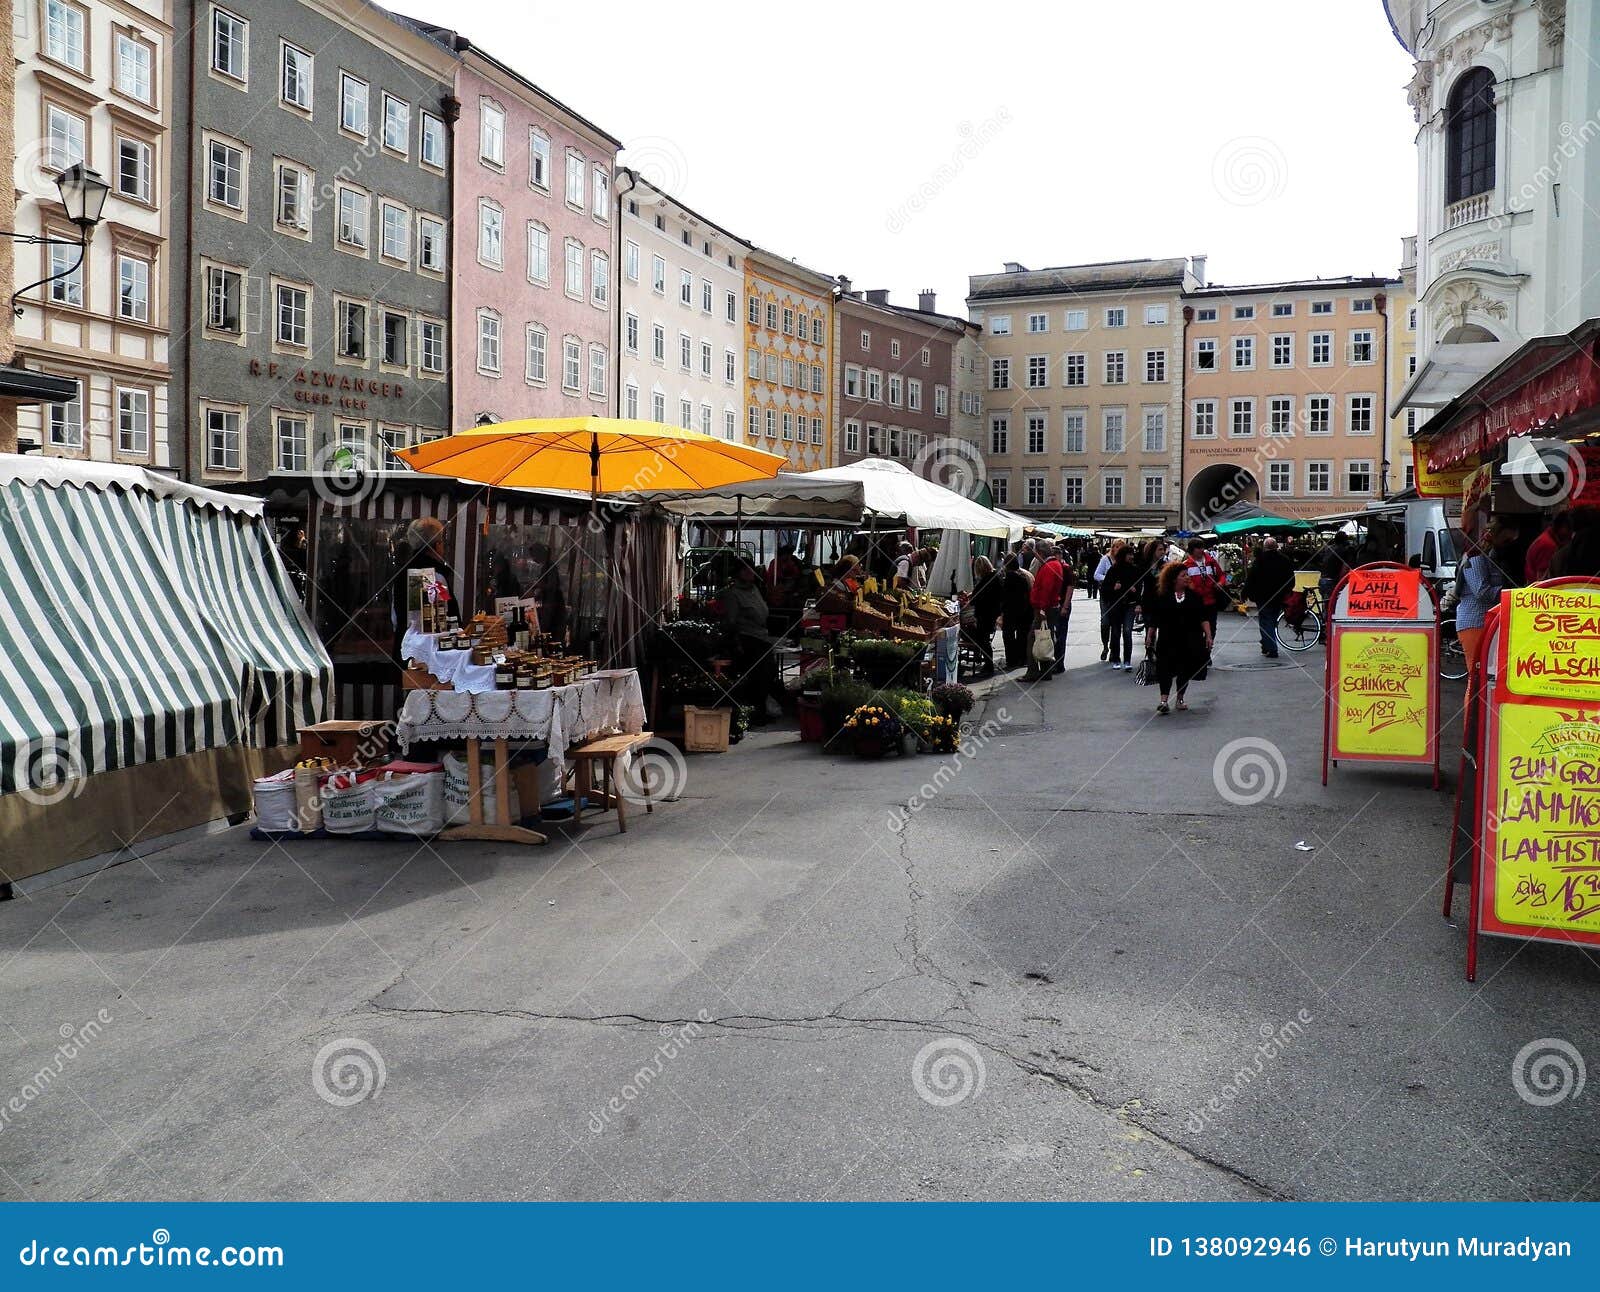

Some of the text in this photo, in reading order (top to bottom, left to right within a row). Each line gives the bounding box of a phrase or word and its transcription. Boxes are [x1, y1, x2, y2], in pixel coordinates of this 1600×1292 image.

[293, 367, 405, 398] AZWANGER
[1343, 673, 1411, 693] SCHINKEN
[1509, 755, 1557, 781] ZUM
[1502, 837, 1600, 864] LAMMST
